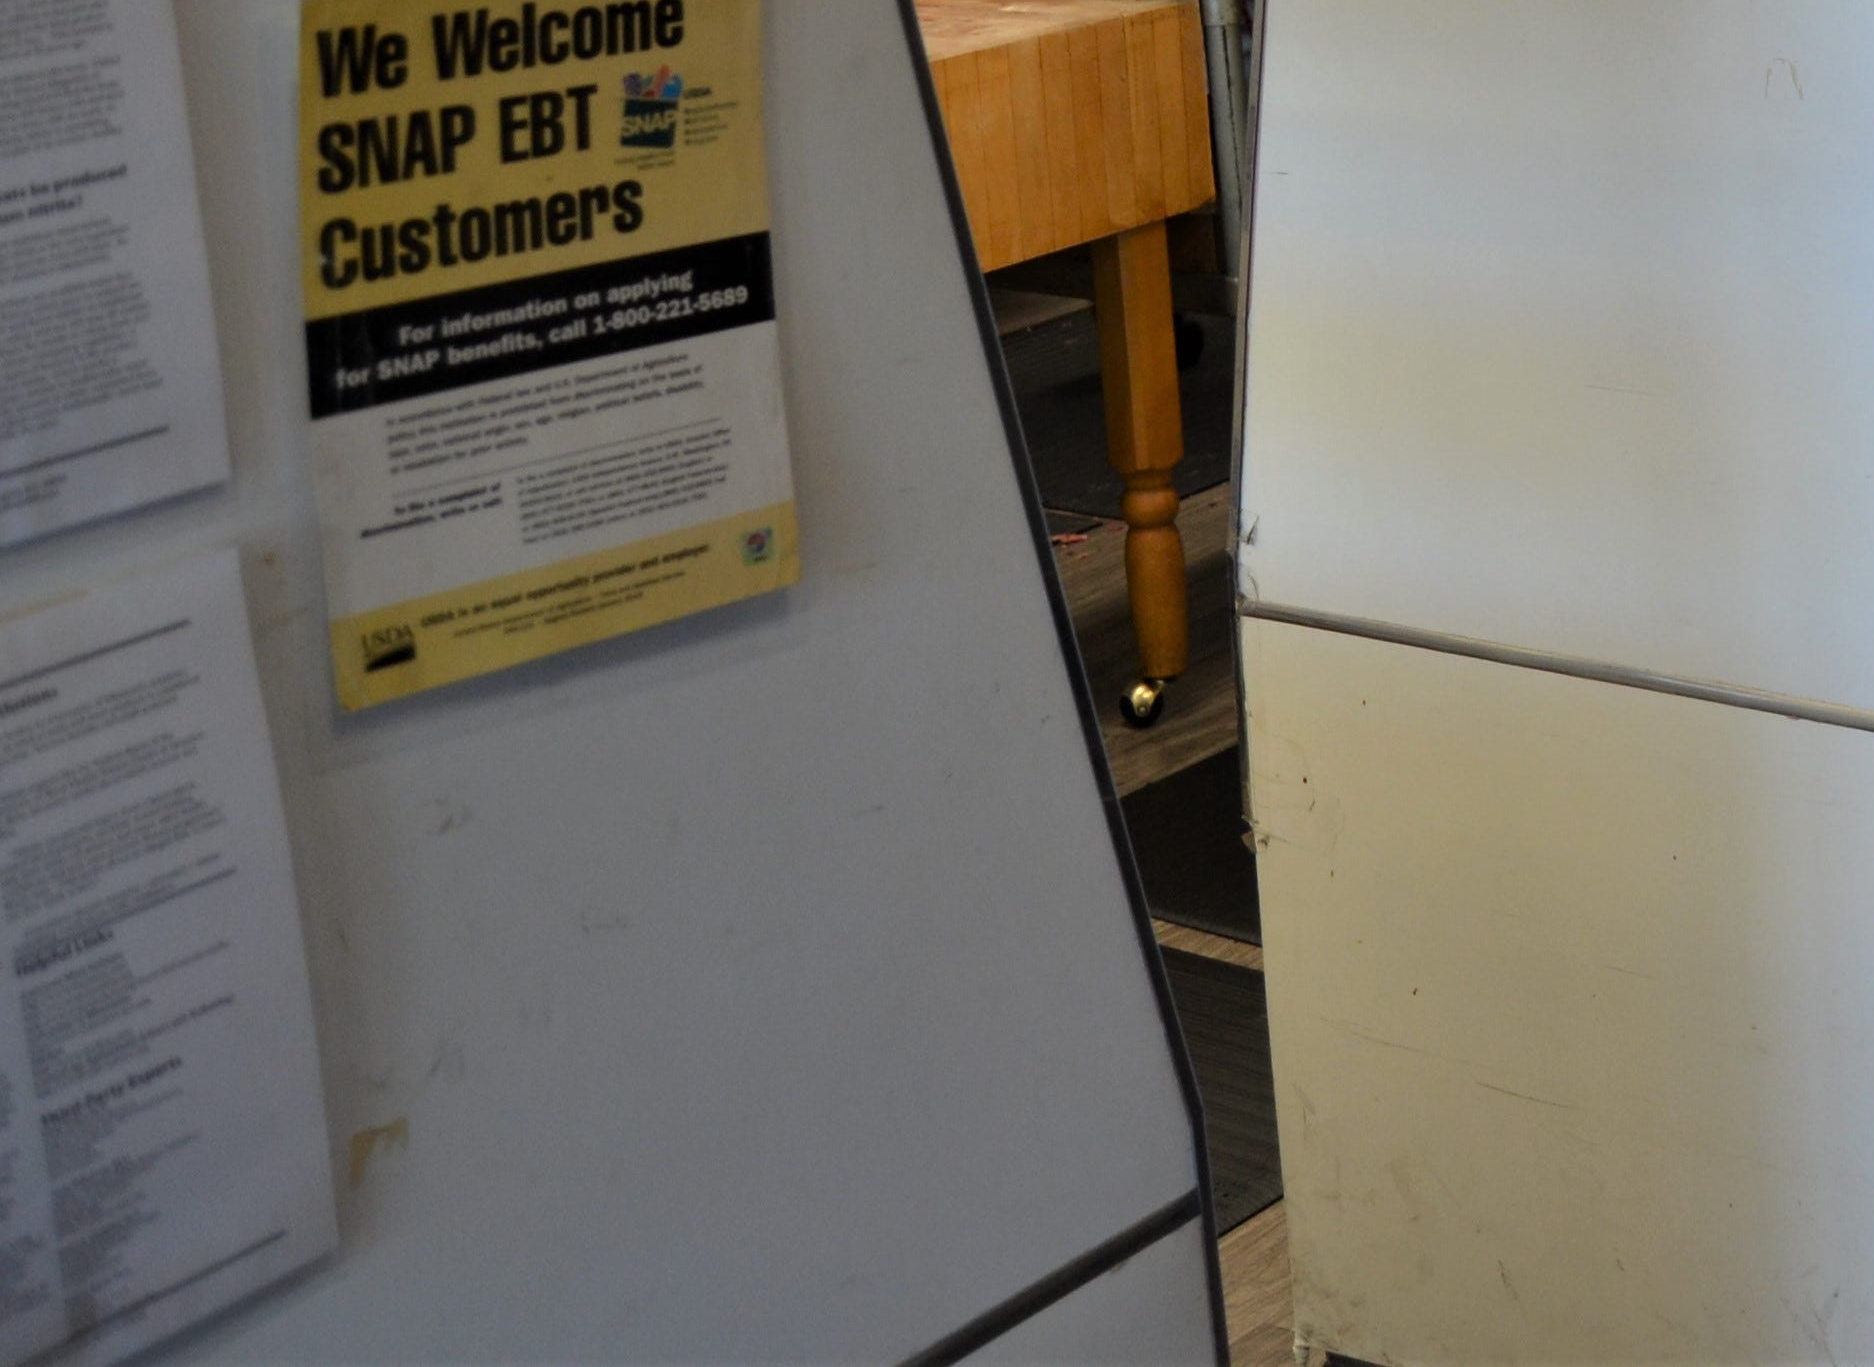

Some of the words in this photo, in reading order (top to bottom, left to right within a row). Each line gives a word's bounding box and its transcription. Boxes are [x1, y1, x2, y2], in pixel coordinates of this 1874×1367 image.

[317, 23, 409, 99] We
[317, 103, 477, 195] SNAP
[499, 84, 599, 164] EBT
[620, 108, 676, 137] SNAP
[319, 179, 643, 291] Customers
[336, 363, 371, 391] for
[376, 350, 440, 382] SNAP
[446, 326, 543, 367] benefits,
[549, 320, 587, 347] call
[592, 284, 750, 336] 1-800-221-5689
[399, 323, 434, 347] For
[441, 298, 568, 339] information
[573, 292, 601, 312] on
[607, 269, 693, 306] applying
[361, 622, 414, 656] USDA
